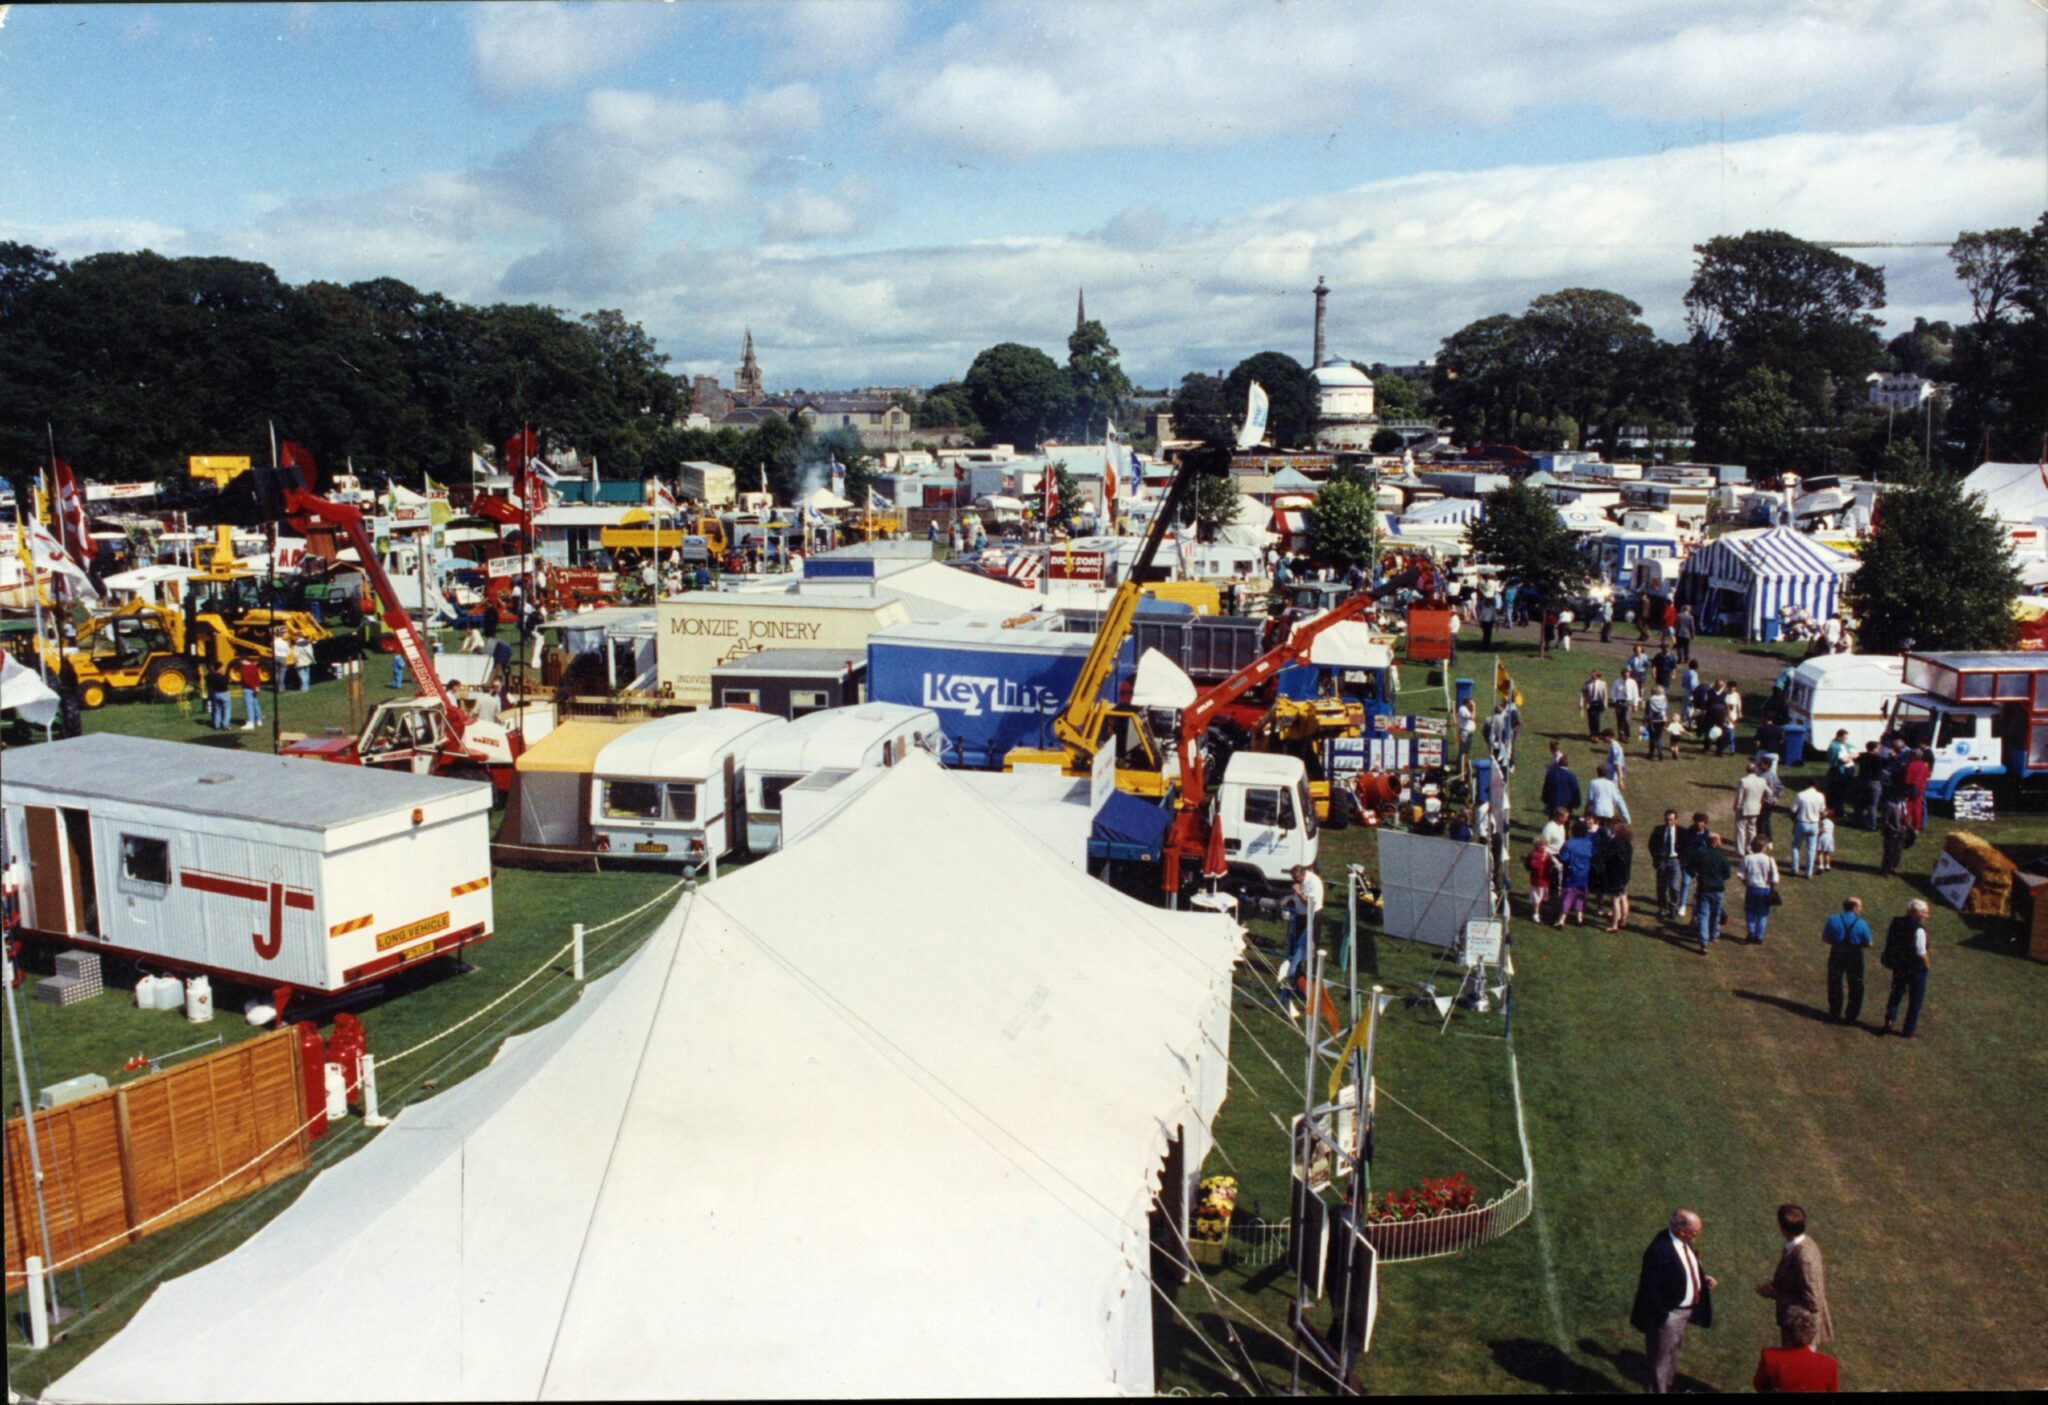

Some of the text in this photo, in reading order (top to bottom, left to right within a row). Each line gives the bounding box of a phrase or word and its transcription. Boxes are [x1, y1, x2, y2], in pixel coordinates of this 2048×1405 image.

[671, 618, 822, 640] MONZIE JOINERY
[378, 916, 448, 948] LONG VEHICLE
